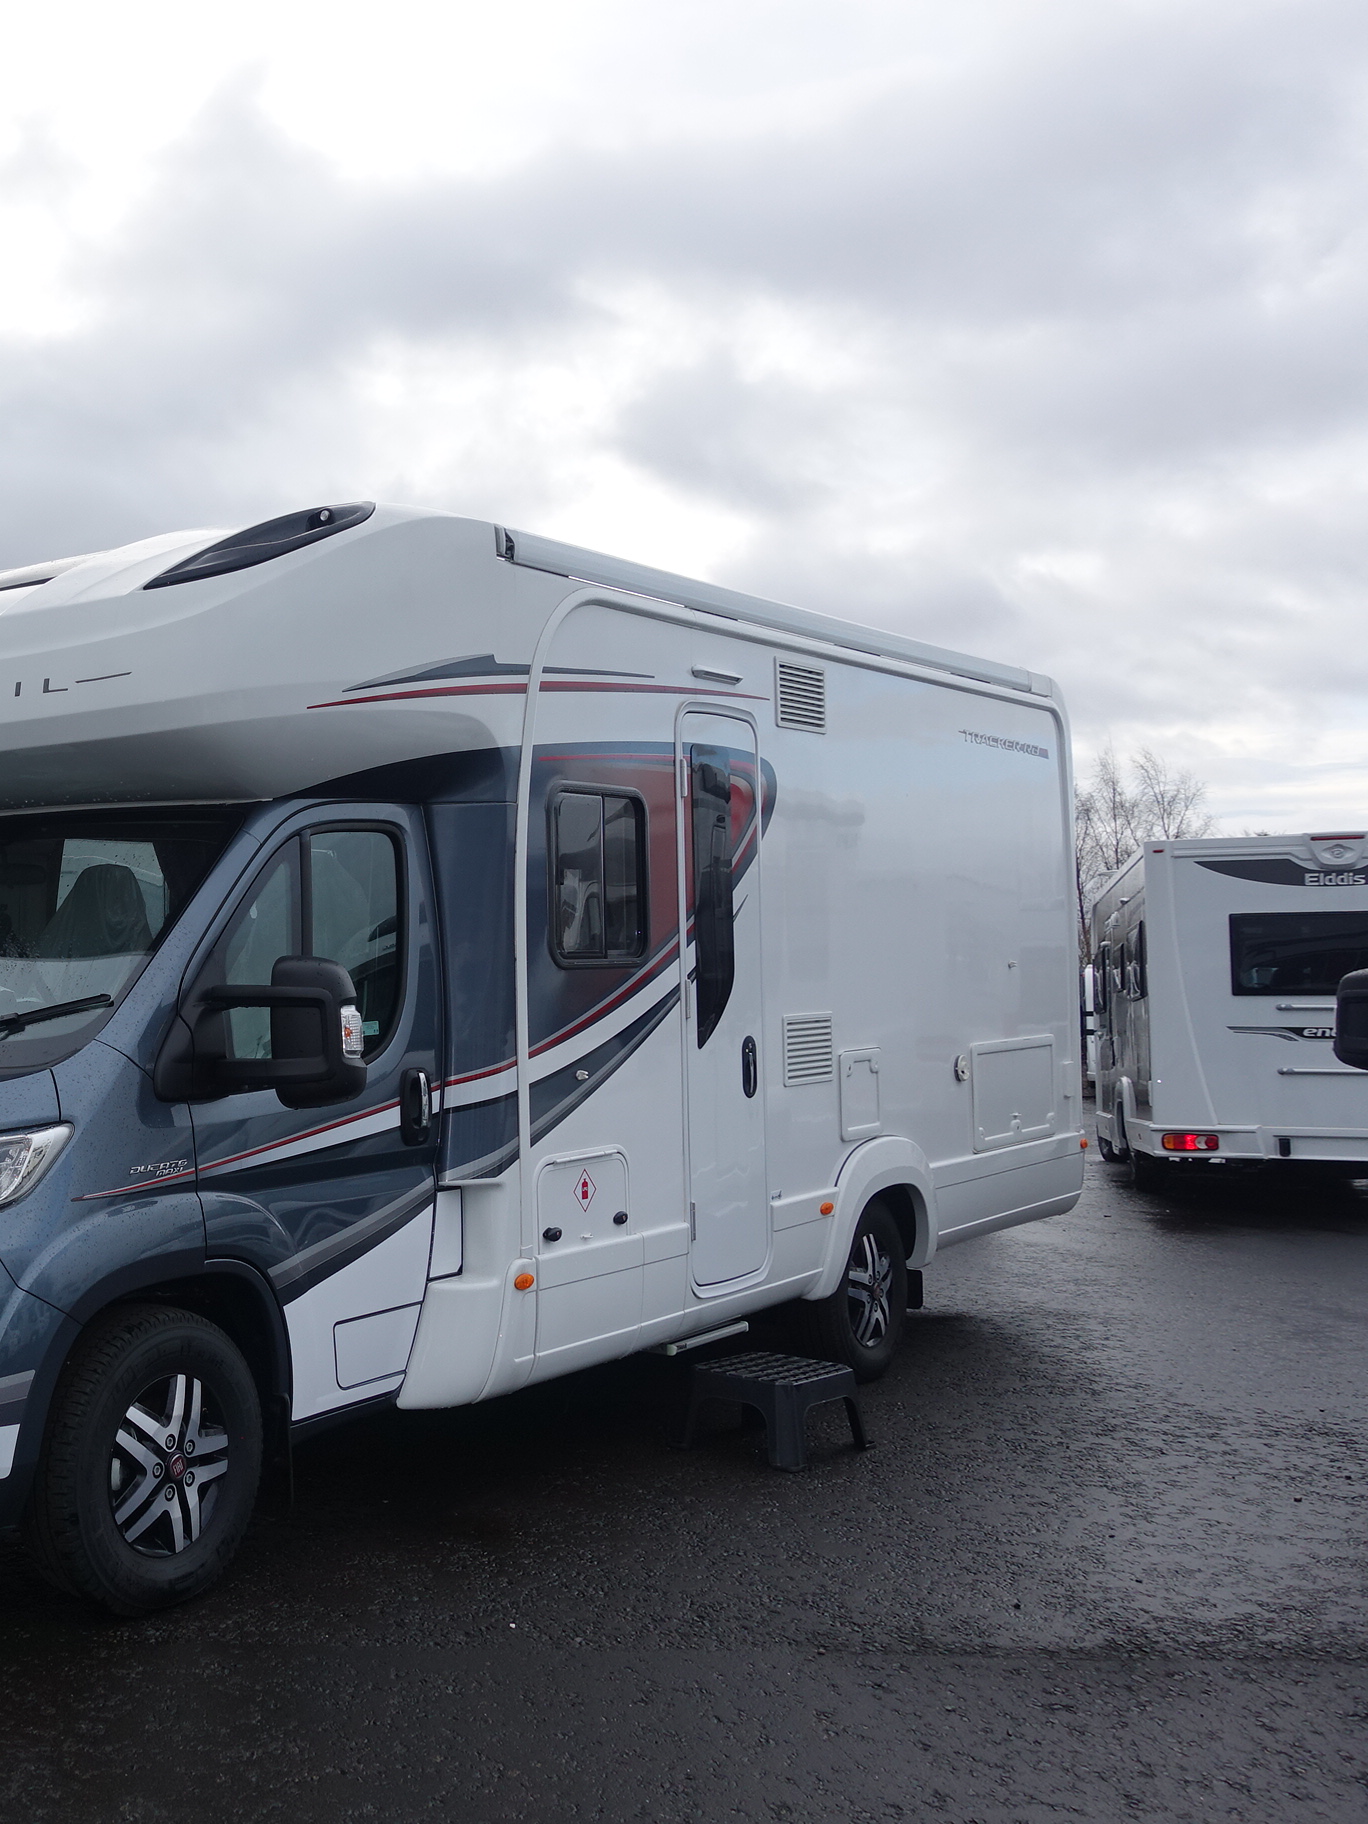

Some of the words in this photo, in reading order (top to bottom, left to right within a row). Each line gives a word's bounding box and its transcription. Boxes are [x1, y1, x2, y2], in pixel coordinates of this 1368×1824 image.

[1304, 872, 1366, 886] Elddis
[129, 1159, 188, 1175] DUCATO
[155, 1167, 184, 1177] MAXI
